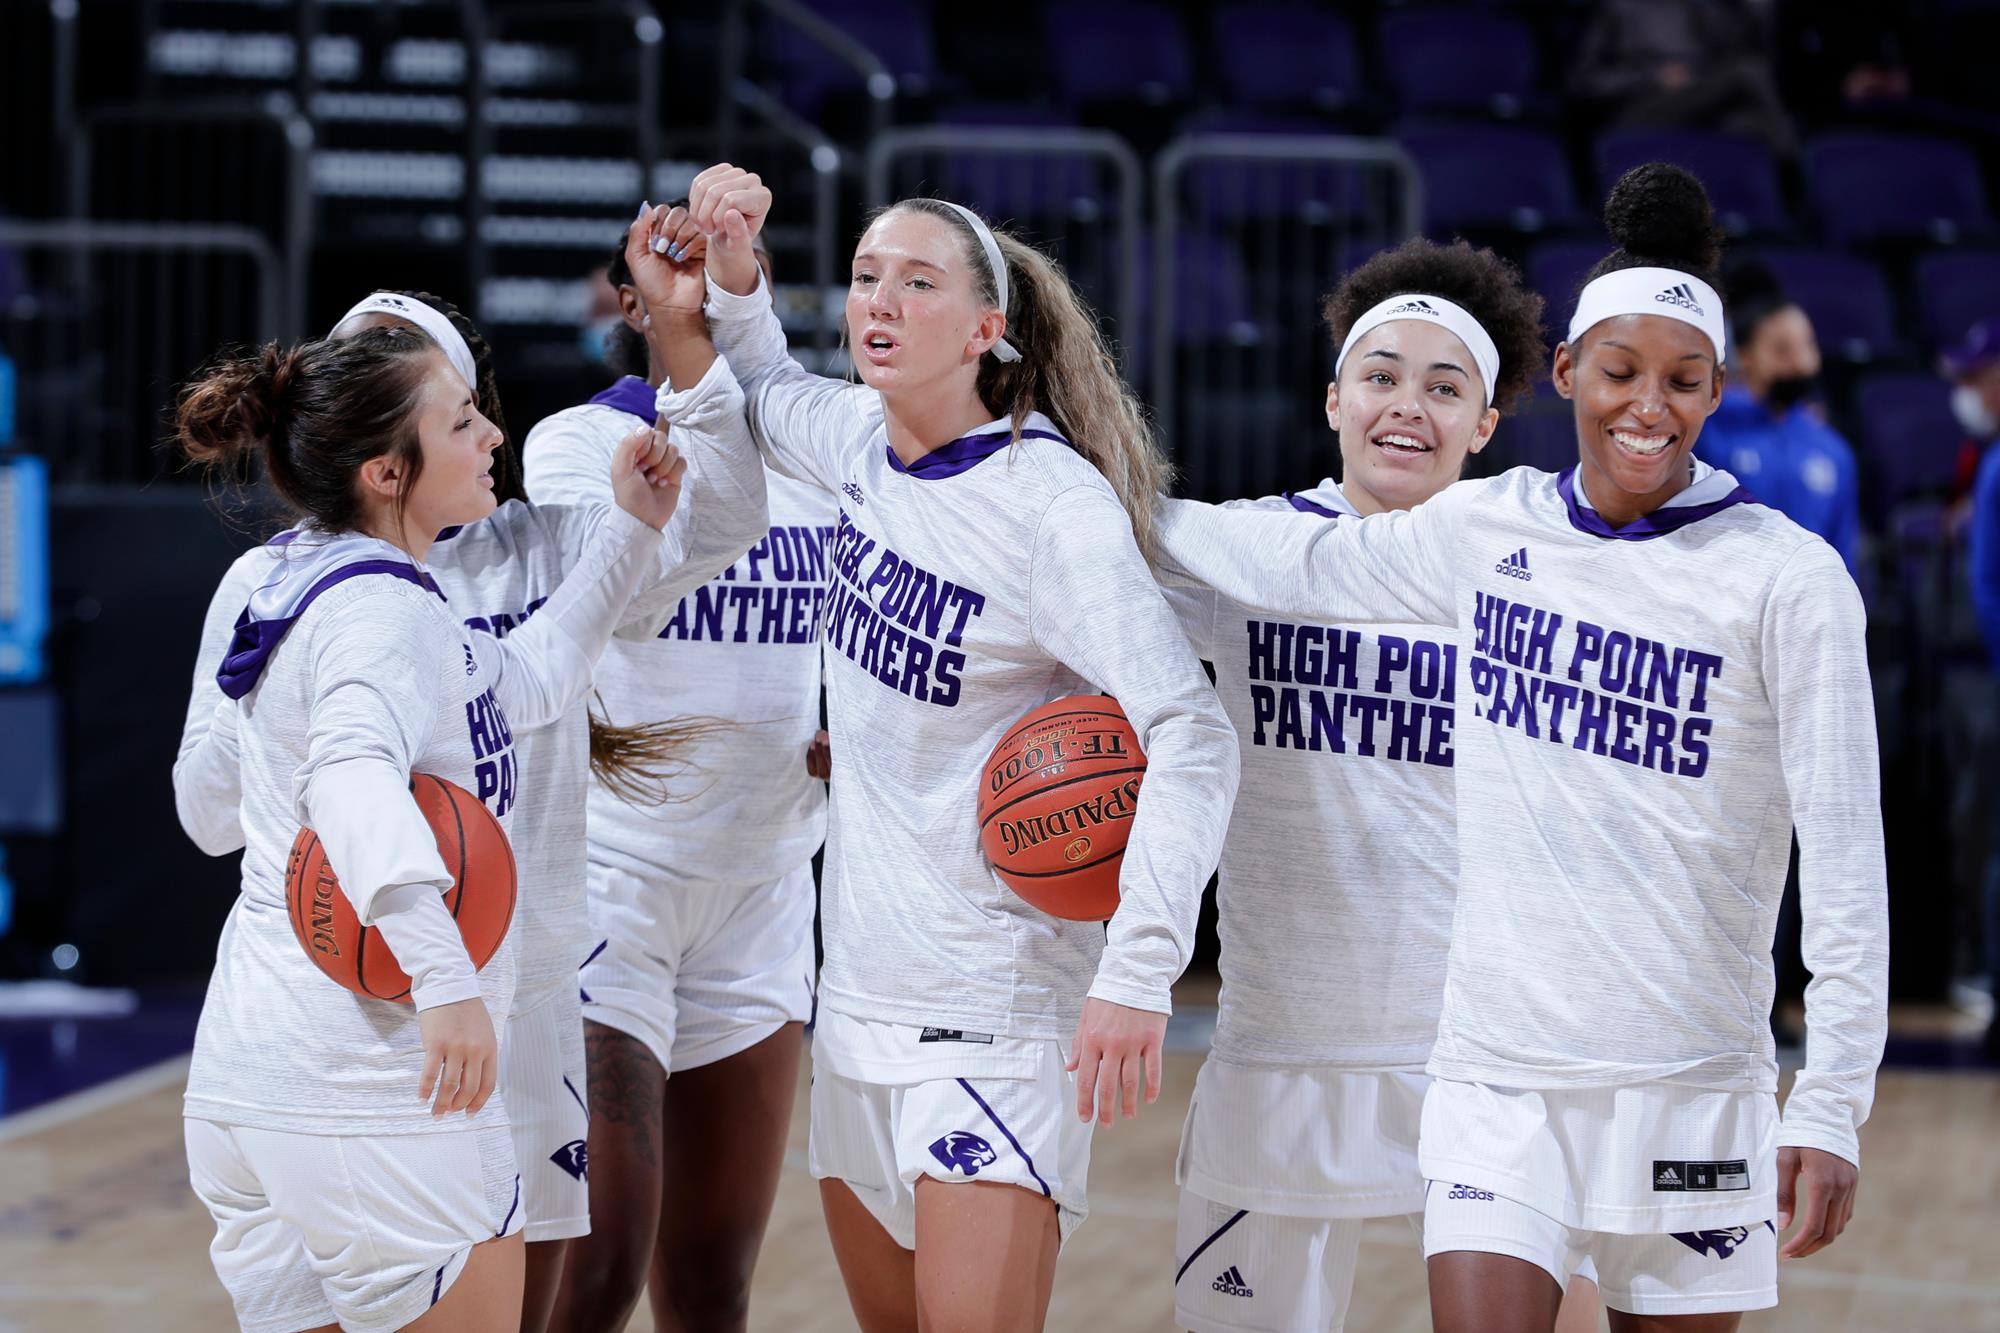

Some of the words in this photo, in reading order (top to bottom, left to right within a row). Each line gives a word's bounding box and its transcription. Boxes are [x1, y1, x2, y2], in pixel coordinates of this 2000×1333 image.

[1386, 304, 1440, 316] adidas
[1655, 294, 1705, 316] adidas
[1495, 562, 1533, 582] adidas
[866, 548, 986, 647] POINT
[1247, 620, 1361, 690] HIGH
[1474, 590, 1563, 675] HIGH
[1568, 620, 1724, 713] POINT
[1250, 684, 1455, 768] PANTHE
[1469, 655, 1713, 778] PANTHERS
[1021, 726, 1079, 751] LEGACY
[991, 734, 1128, 792] TF-1000
[999, 779, 1139, 857] SPALDING
[1448, 1187, 1495, 1201] adidas
[1698, 1174, 1706, 1184] M
[1212, 1282, 1254, 1298] adidas
